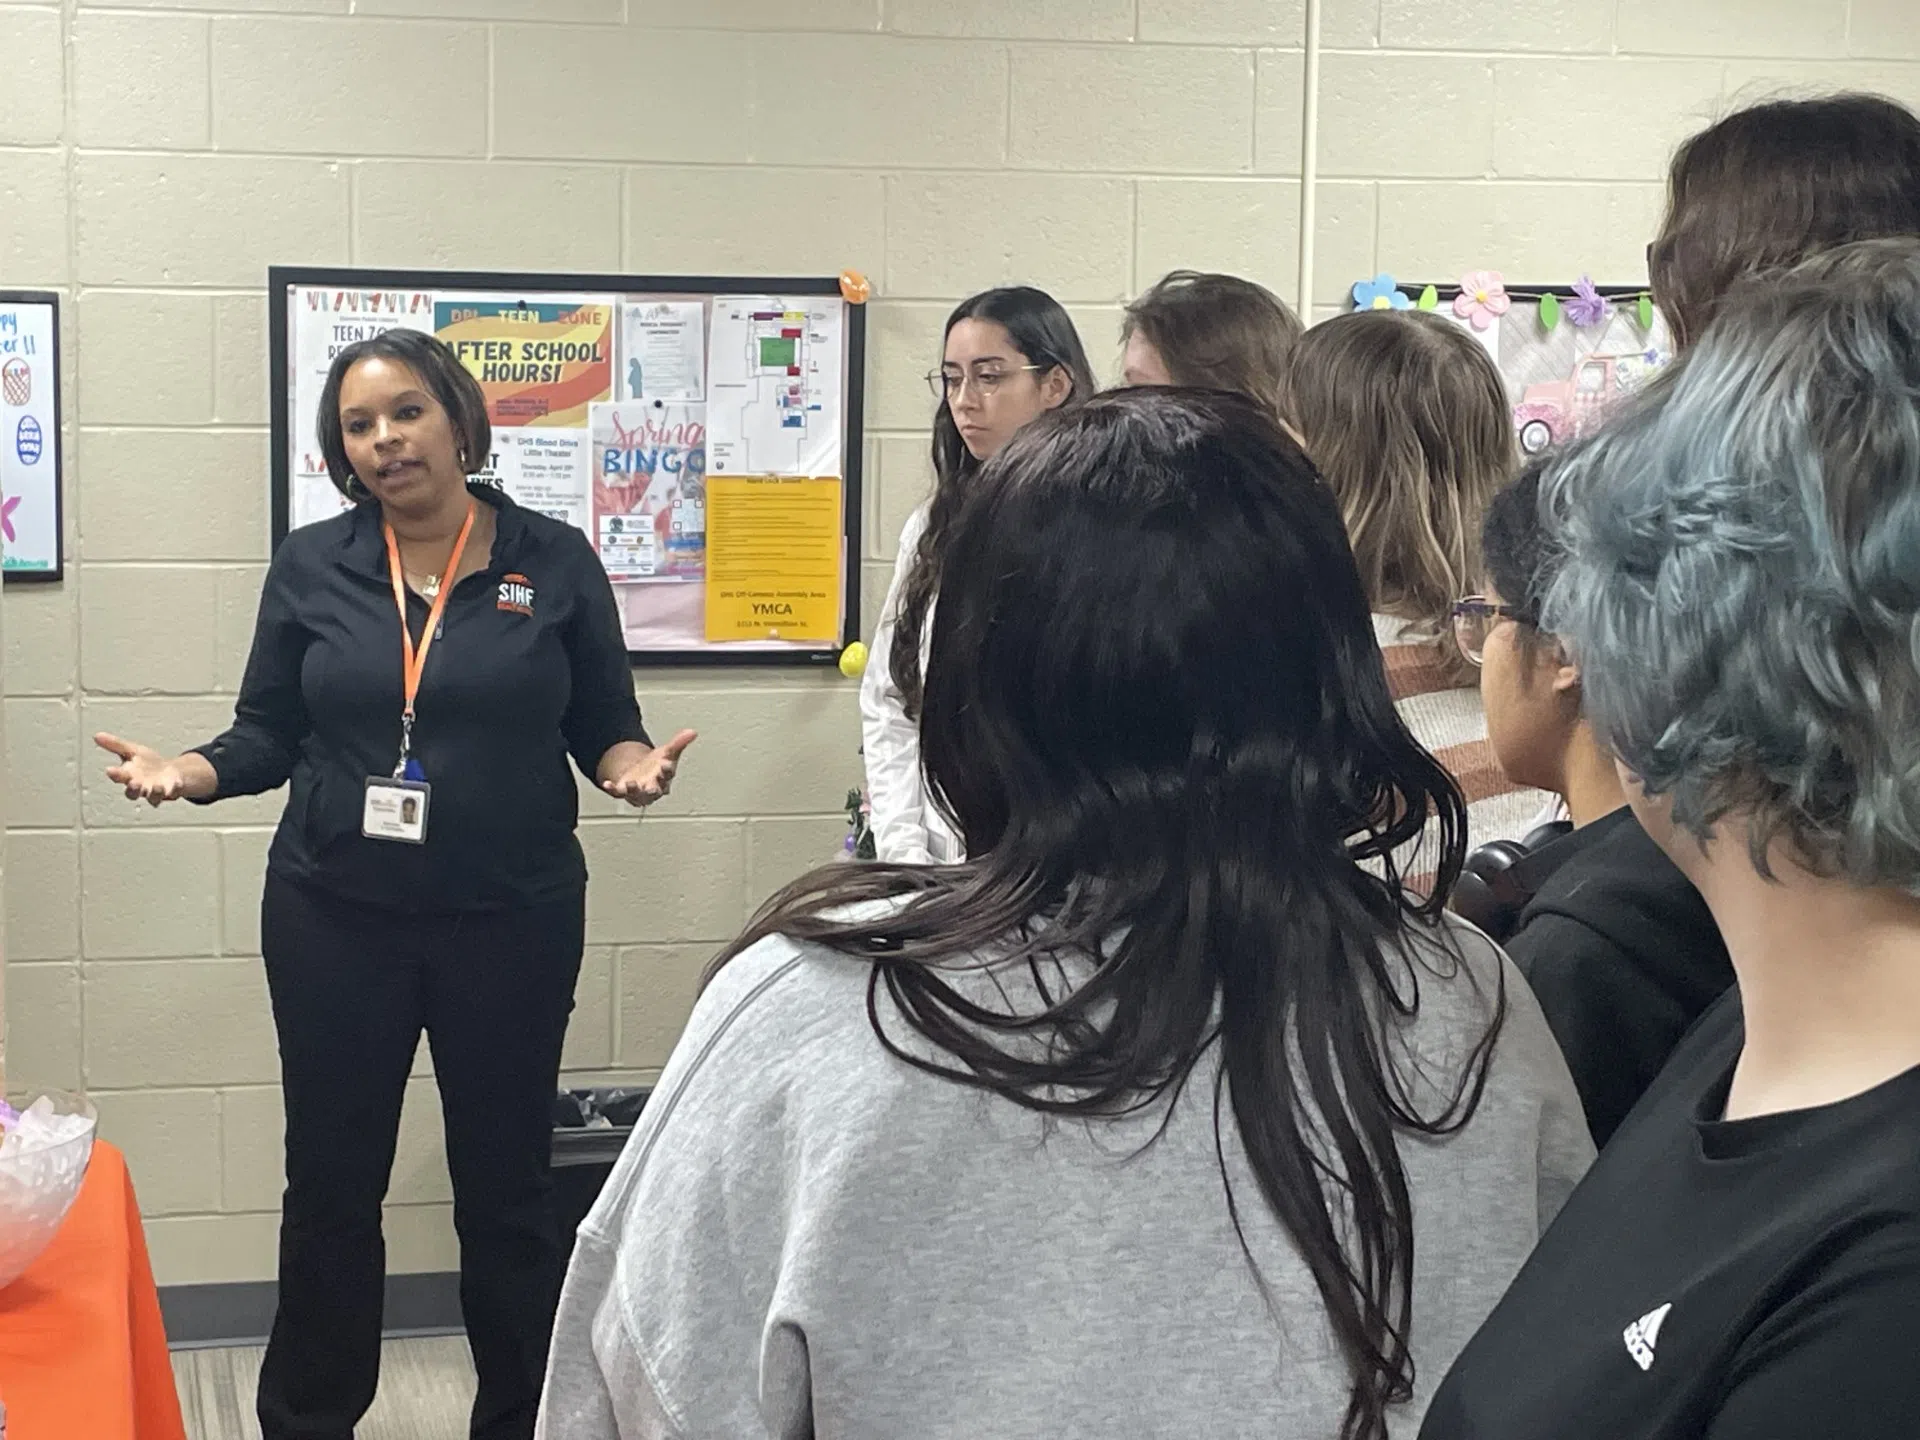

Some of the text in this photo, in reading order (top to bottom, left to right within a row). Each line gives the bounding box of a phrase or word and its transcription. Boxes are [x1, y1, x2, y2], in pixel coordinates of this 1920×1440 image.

[498, 309, 540, 324] TEEN
[558, 311, 603, 325] ZONE
[332, 325, 364, 342] TEEN
[521, 342, 605, 363] SCHOOL
[612, 411, 706, 450] Spring
[603, 448, 706, 474] BINGO
[498, 582, 534, 606] SIHF
[752, 604, 792, 615] YMCA
